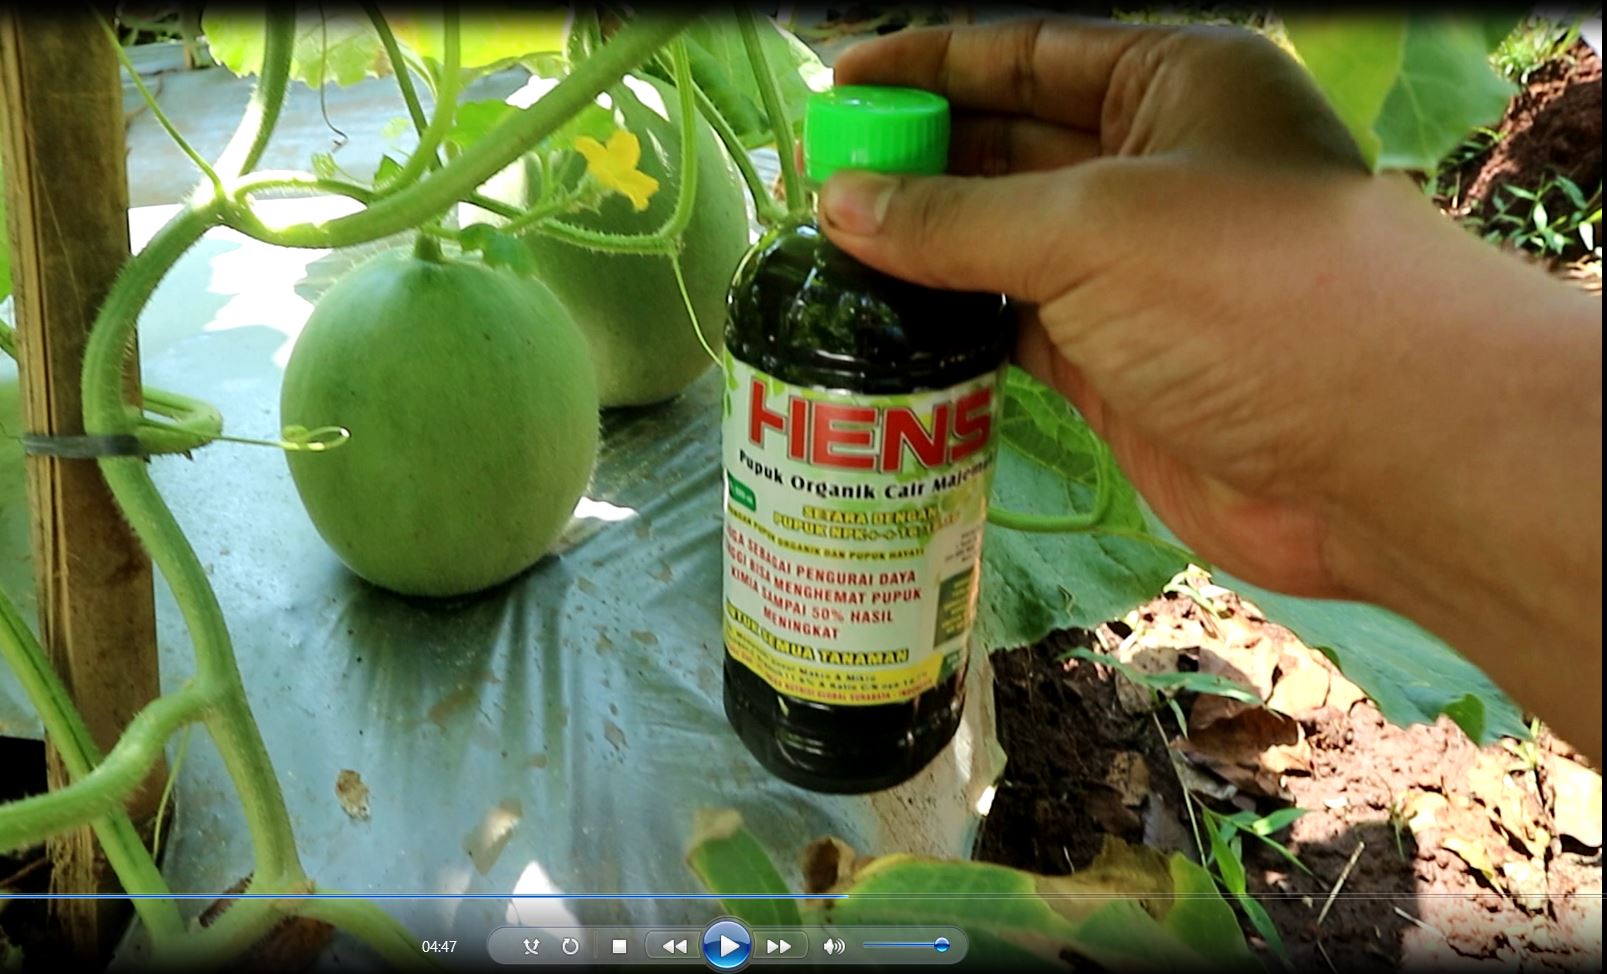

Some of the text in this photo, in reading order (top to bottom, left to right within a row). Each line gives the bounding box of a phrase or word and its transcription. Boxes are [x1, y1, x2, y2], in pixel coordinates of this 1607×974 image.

[748, 378, 994, 474] HENS
[739, 449, 784, 485] Pupuk
[790, 475, 876, 500] Organik
[884, 483, 925, 499] Cair
[772, 511, 827, 539] PUPUK
[802, 505, 868, 526] SETARA
[747, 538, 791, 575] SEBAGAI
[796, 563, 874, 587] PENGURAI
[879, 570, 916, 585] DAYA
[761, 585, 807, 617] SAMPAI
[850, 610, 893, 624] HASIL
[774, 575, 865, 606] MENGHEMAT
[871, 588, 922, 605] PUPUK
[762, 605, 839, 640] MENINGKAT
[760, 628, 816, 661] SEMUA
[818, 648, 910, 667] TANAMAN
